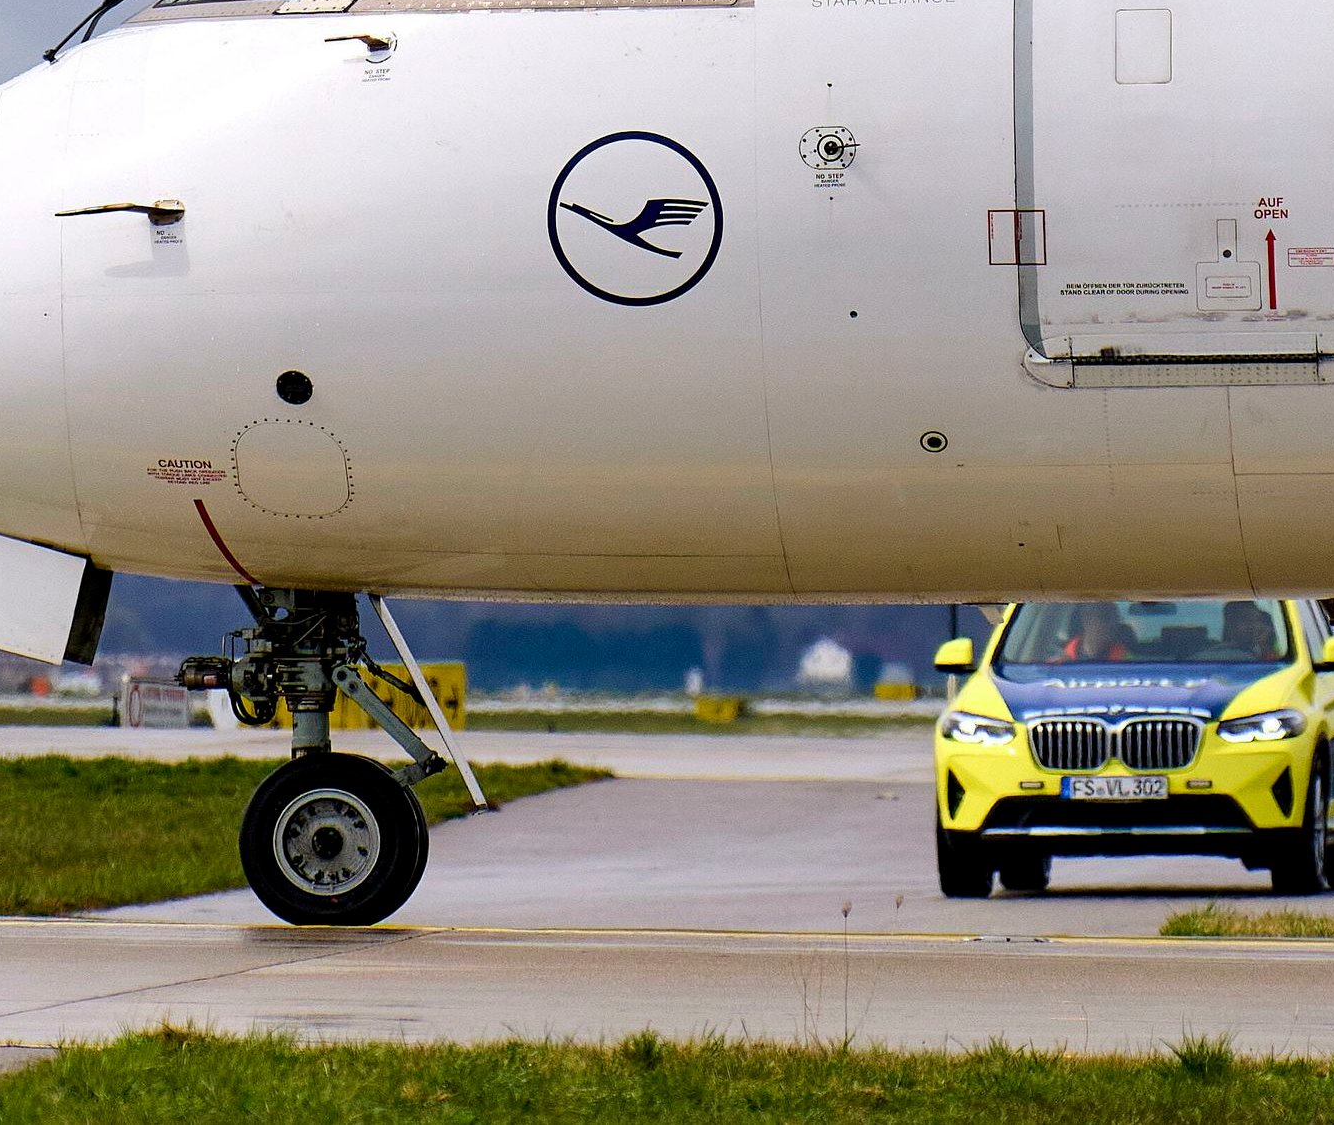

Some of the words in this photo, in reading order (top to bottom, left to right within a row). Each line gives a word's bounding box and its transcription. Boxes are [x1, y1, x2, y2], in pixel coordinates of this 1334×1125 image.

[1258, 197, 1284, 208] AUF
[1253, 208, 1289, 220] OPEN
[158, 459, 212, 469] CAUTION
[1132, 778, 1164, 796] 302
